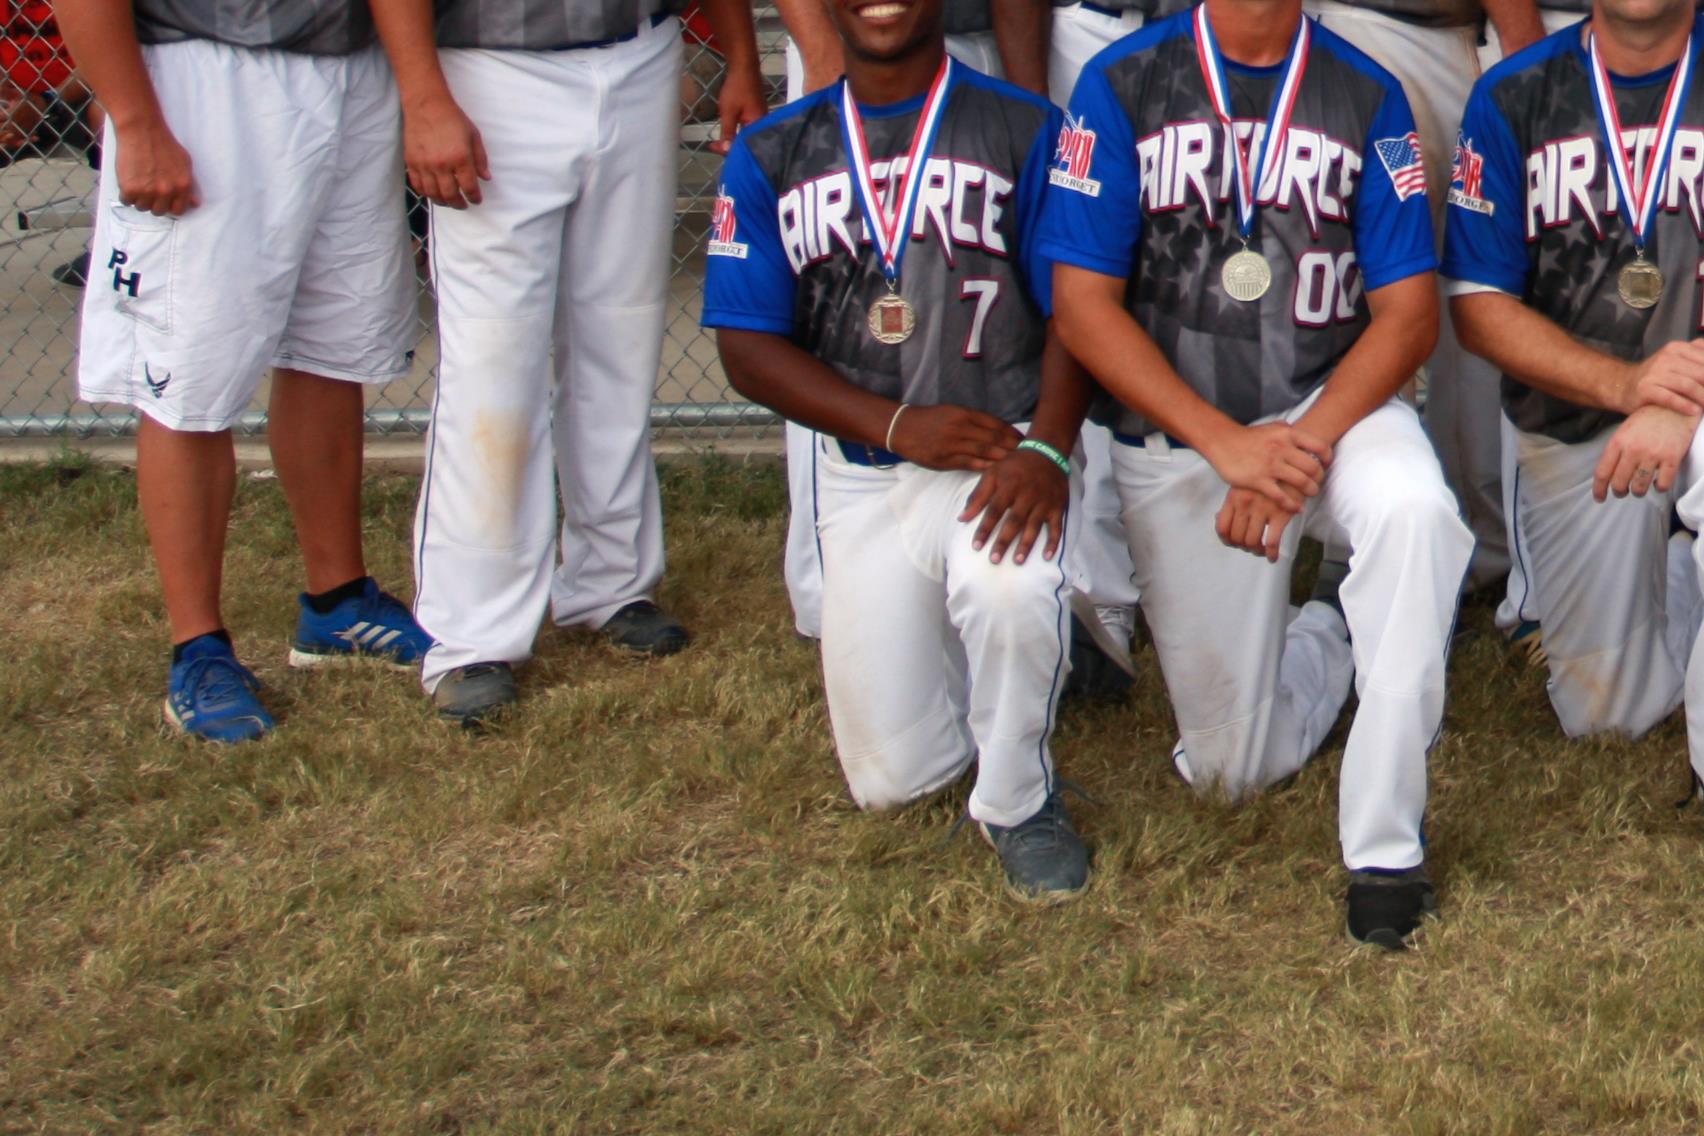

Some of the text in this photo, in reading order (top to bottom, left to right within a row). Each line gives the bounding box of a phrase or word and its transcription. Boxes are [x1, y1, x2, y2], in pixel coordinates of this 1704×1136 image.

[778, 169, 858, 276] AIR
[1136, 121, 1216, 227] AIR
[1525, 136, 1605, 242] AIR
[959, 278, 1000, 358] 7
